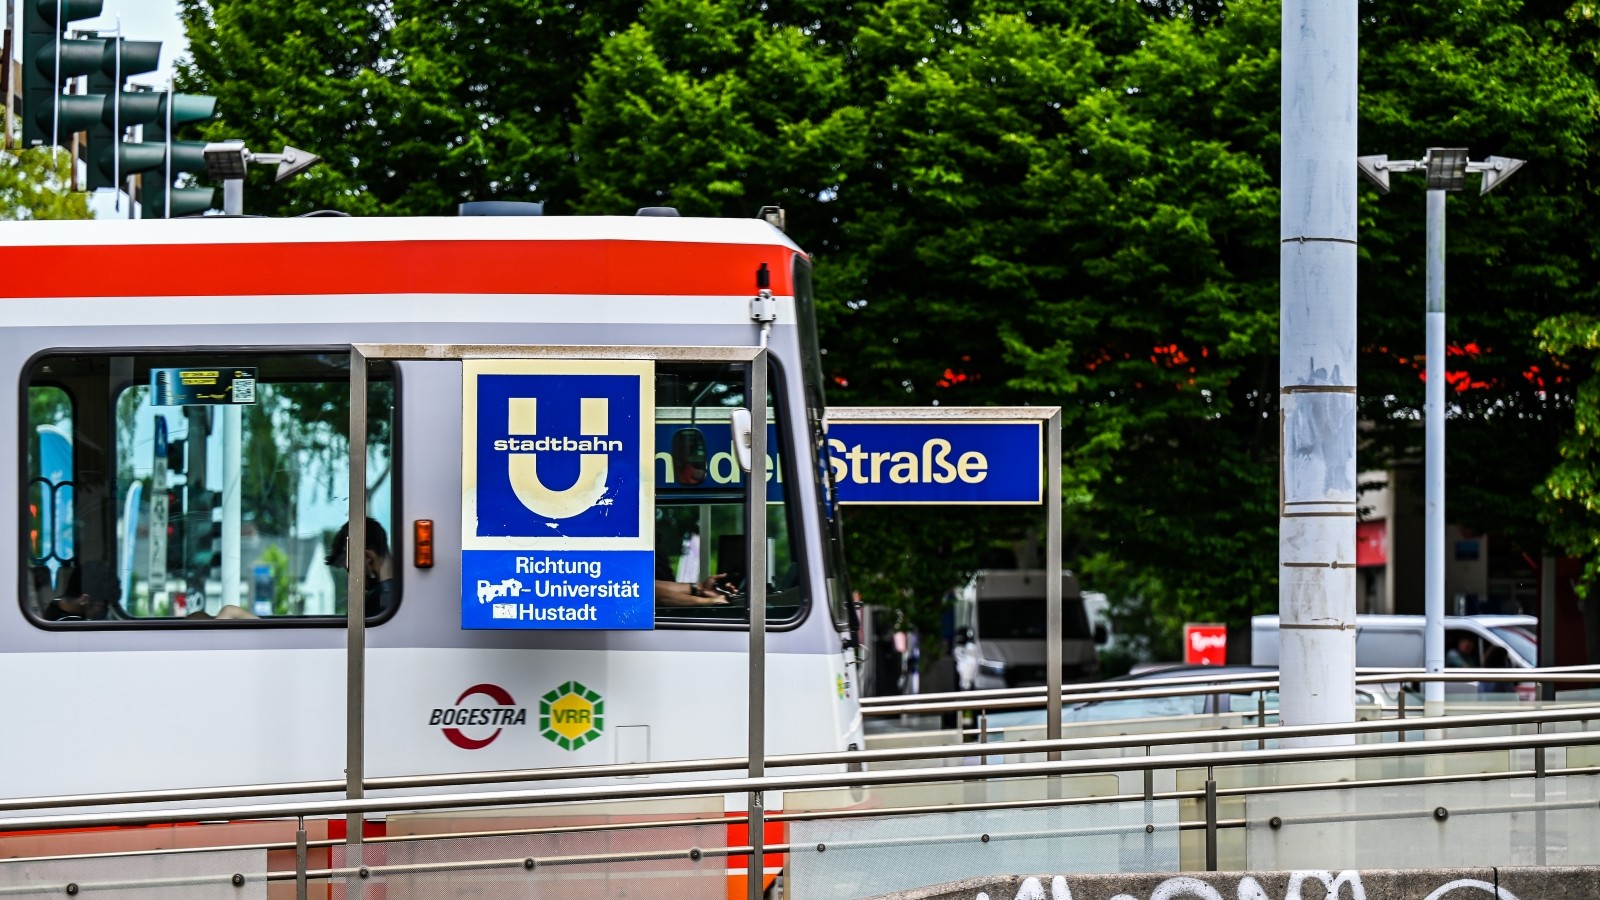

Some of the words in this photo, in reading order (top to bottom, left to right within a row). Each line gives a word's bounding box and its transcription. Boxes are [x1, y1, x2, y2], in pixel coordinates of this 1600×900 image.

[493, 436, 623, 452] stadtbahn
[827, 438, 988, 484] Straße
[515, 556, 602, 578] Richtung
[535, 580, 640, 598] Universität
[519, 603, 598, 621] Hustadt
[428, 708, 527, 726] BOGESTRA
[553, 709, 591, 724] VRR
